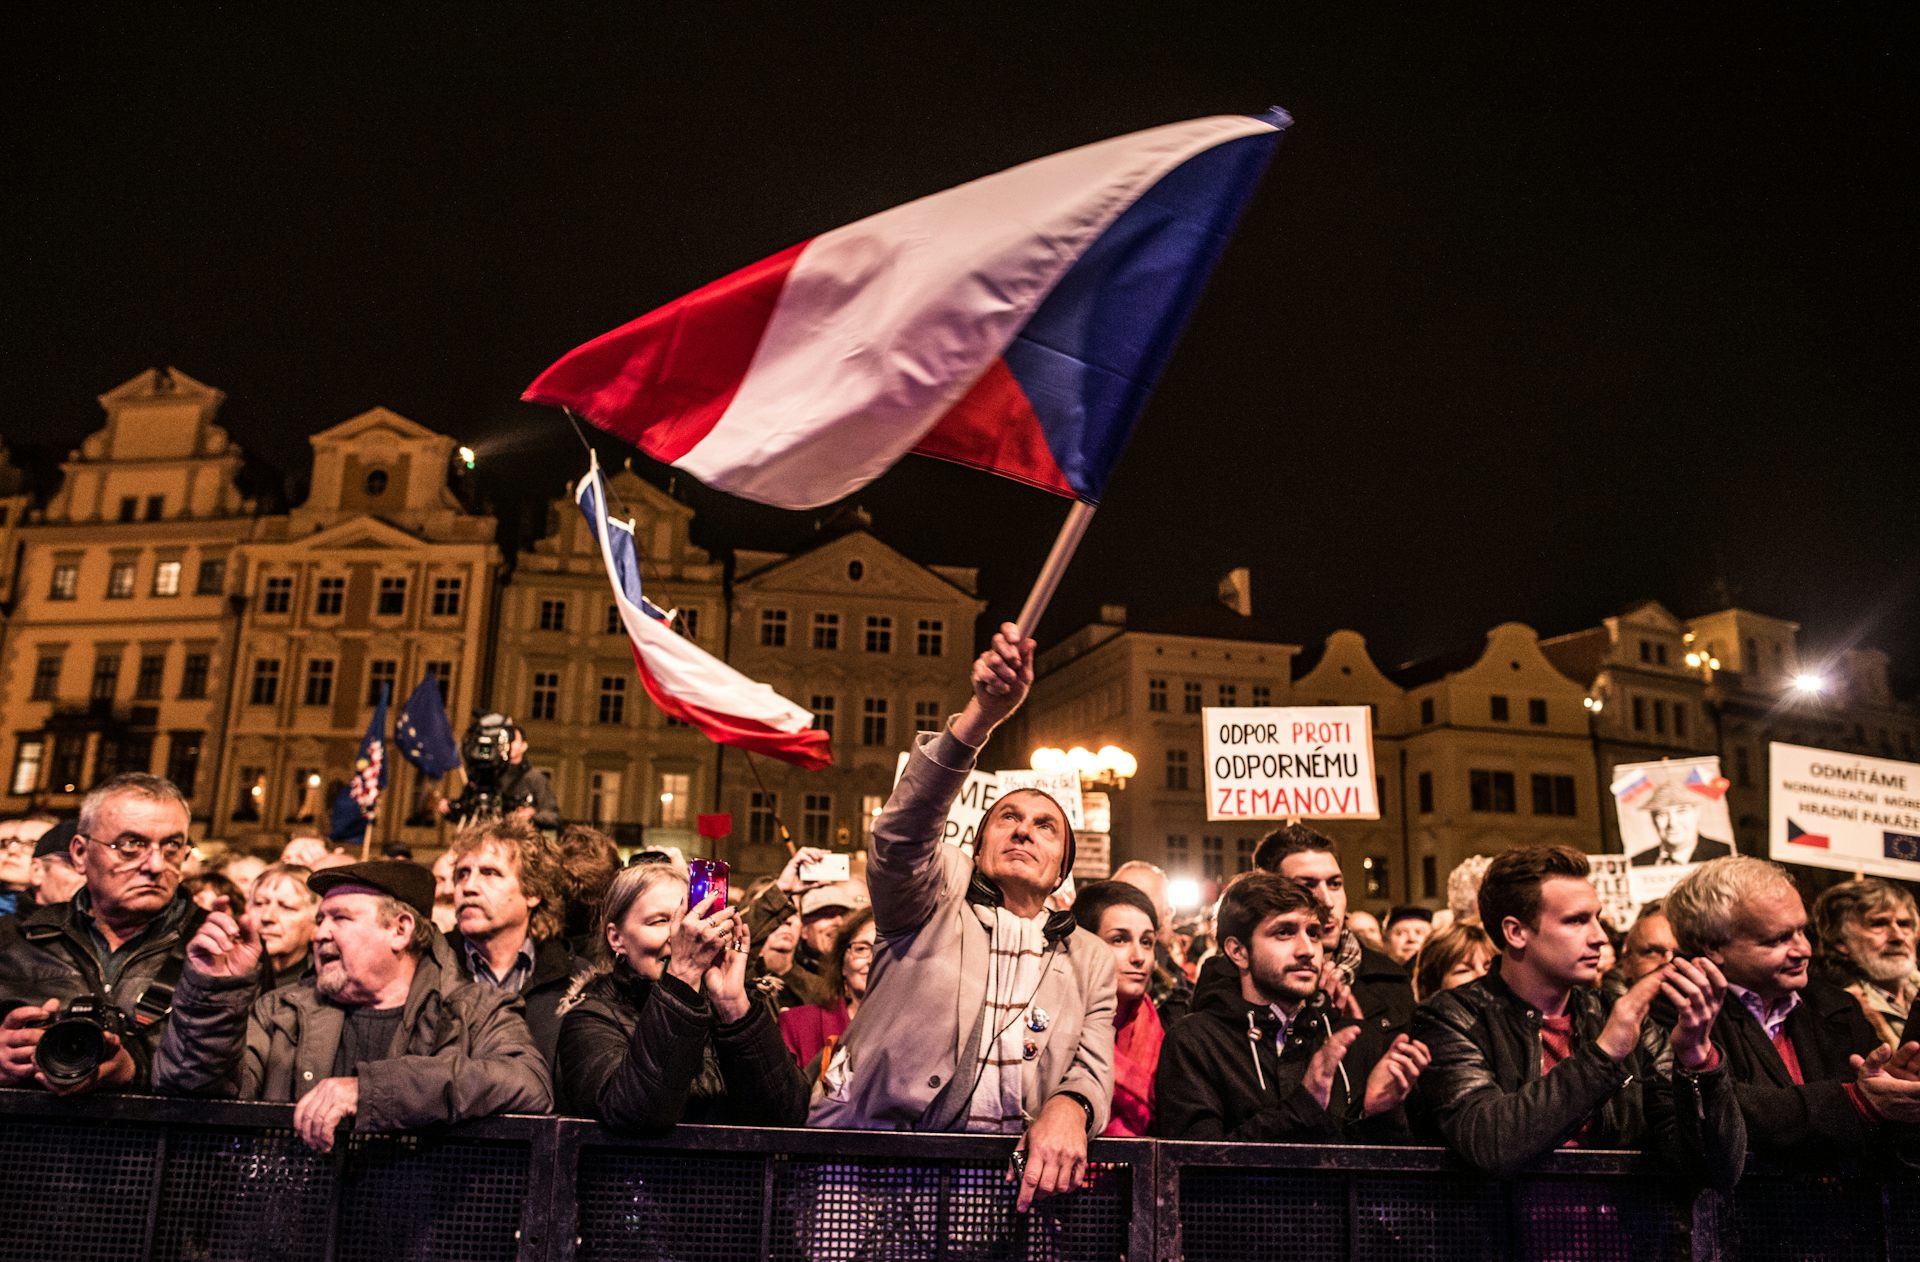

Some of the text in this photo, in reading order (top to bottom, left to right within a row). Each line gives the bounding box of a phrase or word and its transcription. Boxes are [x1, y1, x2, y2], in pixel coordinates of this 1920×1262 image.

[1219, 721, 1351, 744] ODPOR PROTI
[1215, 745, 1358, 779] ODPORNÉMU
[1809, 761, 1908, 791] ODMÍTÁME
[1218, 787, 1360, 815] ZEMANOVI
